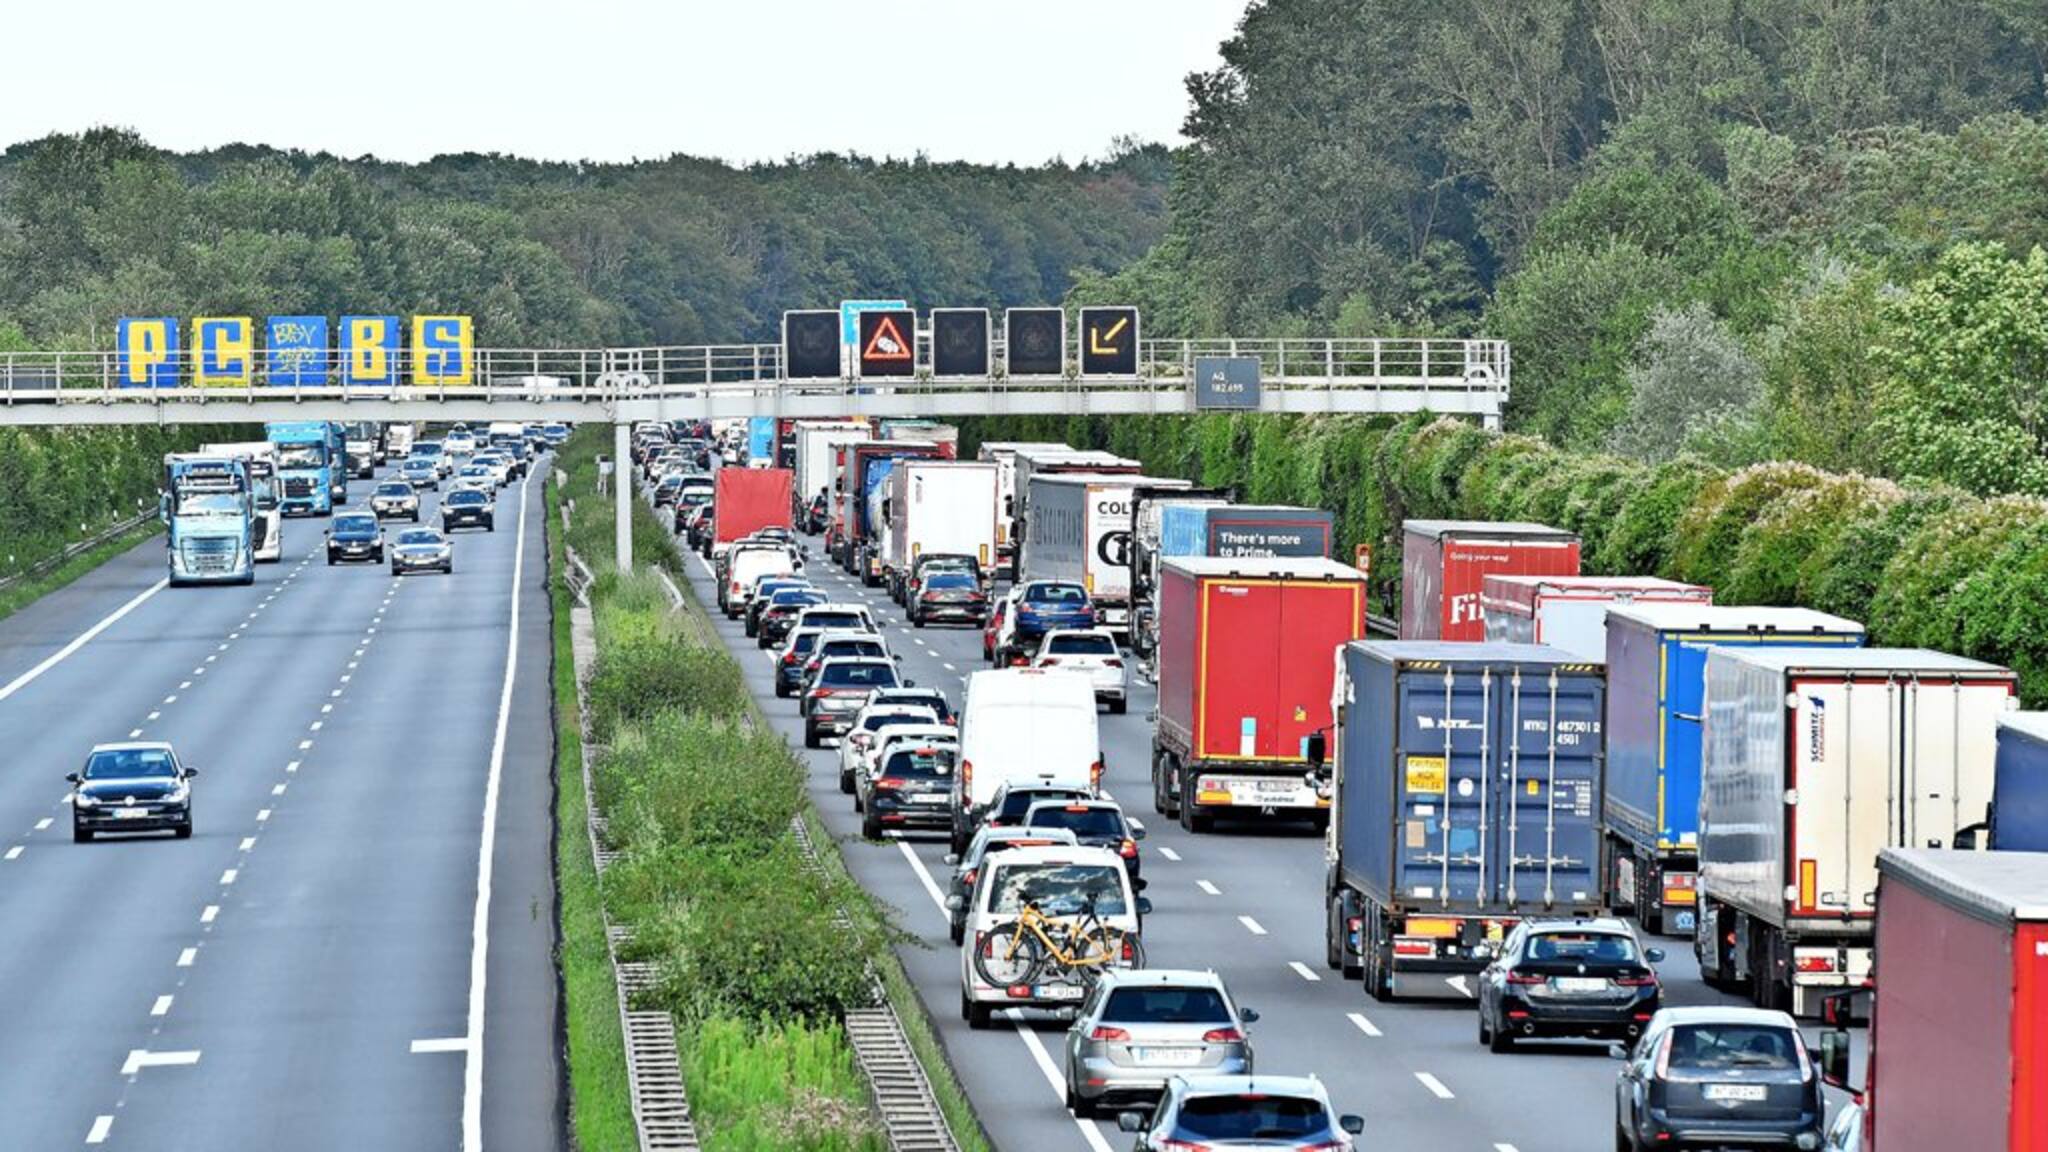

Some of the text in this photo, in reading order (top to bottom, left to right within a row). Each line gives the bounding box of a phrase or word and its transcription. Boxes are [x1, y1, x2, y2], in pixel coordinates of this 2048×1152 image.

[1220, 532, 1301, 545] There's more
[1220, 546, 1234, 558] to
[1810, 711, 1819, 763] SCHMITZ
